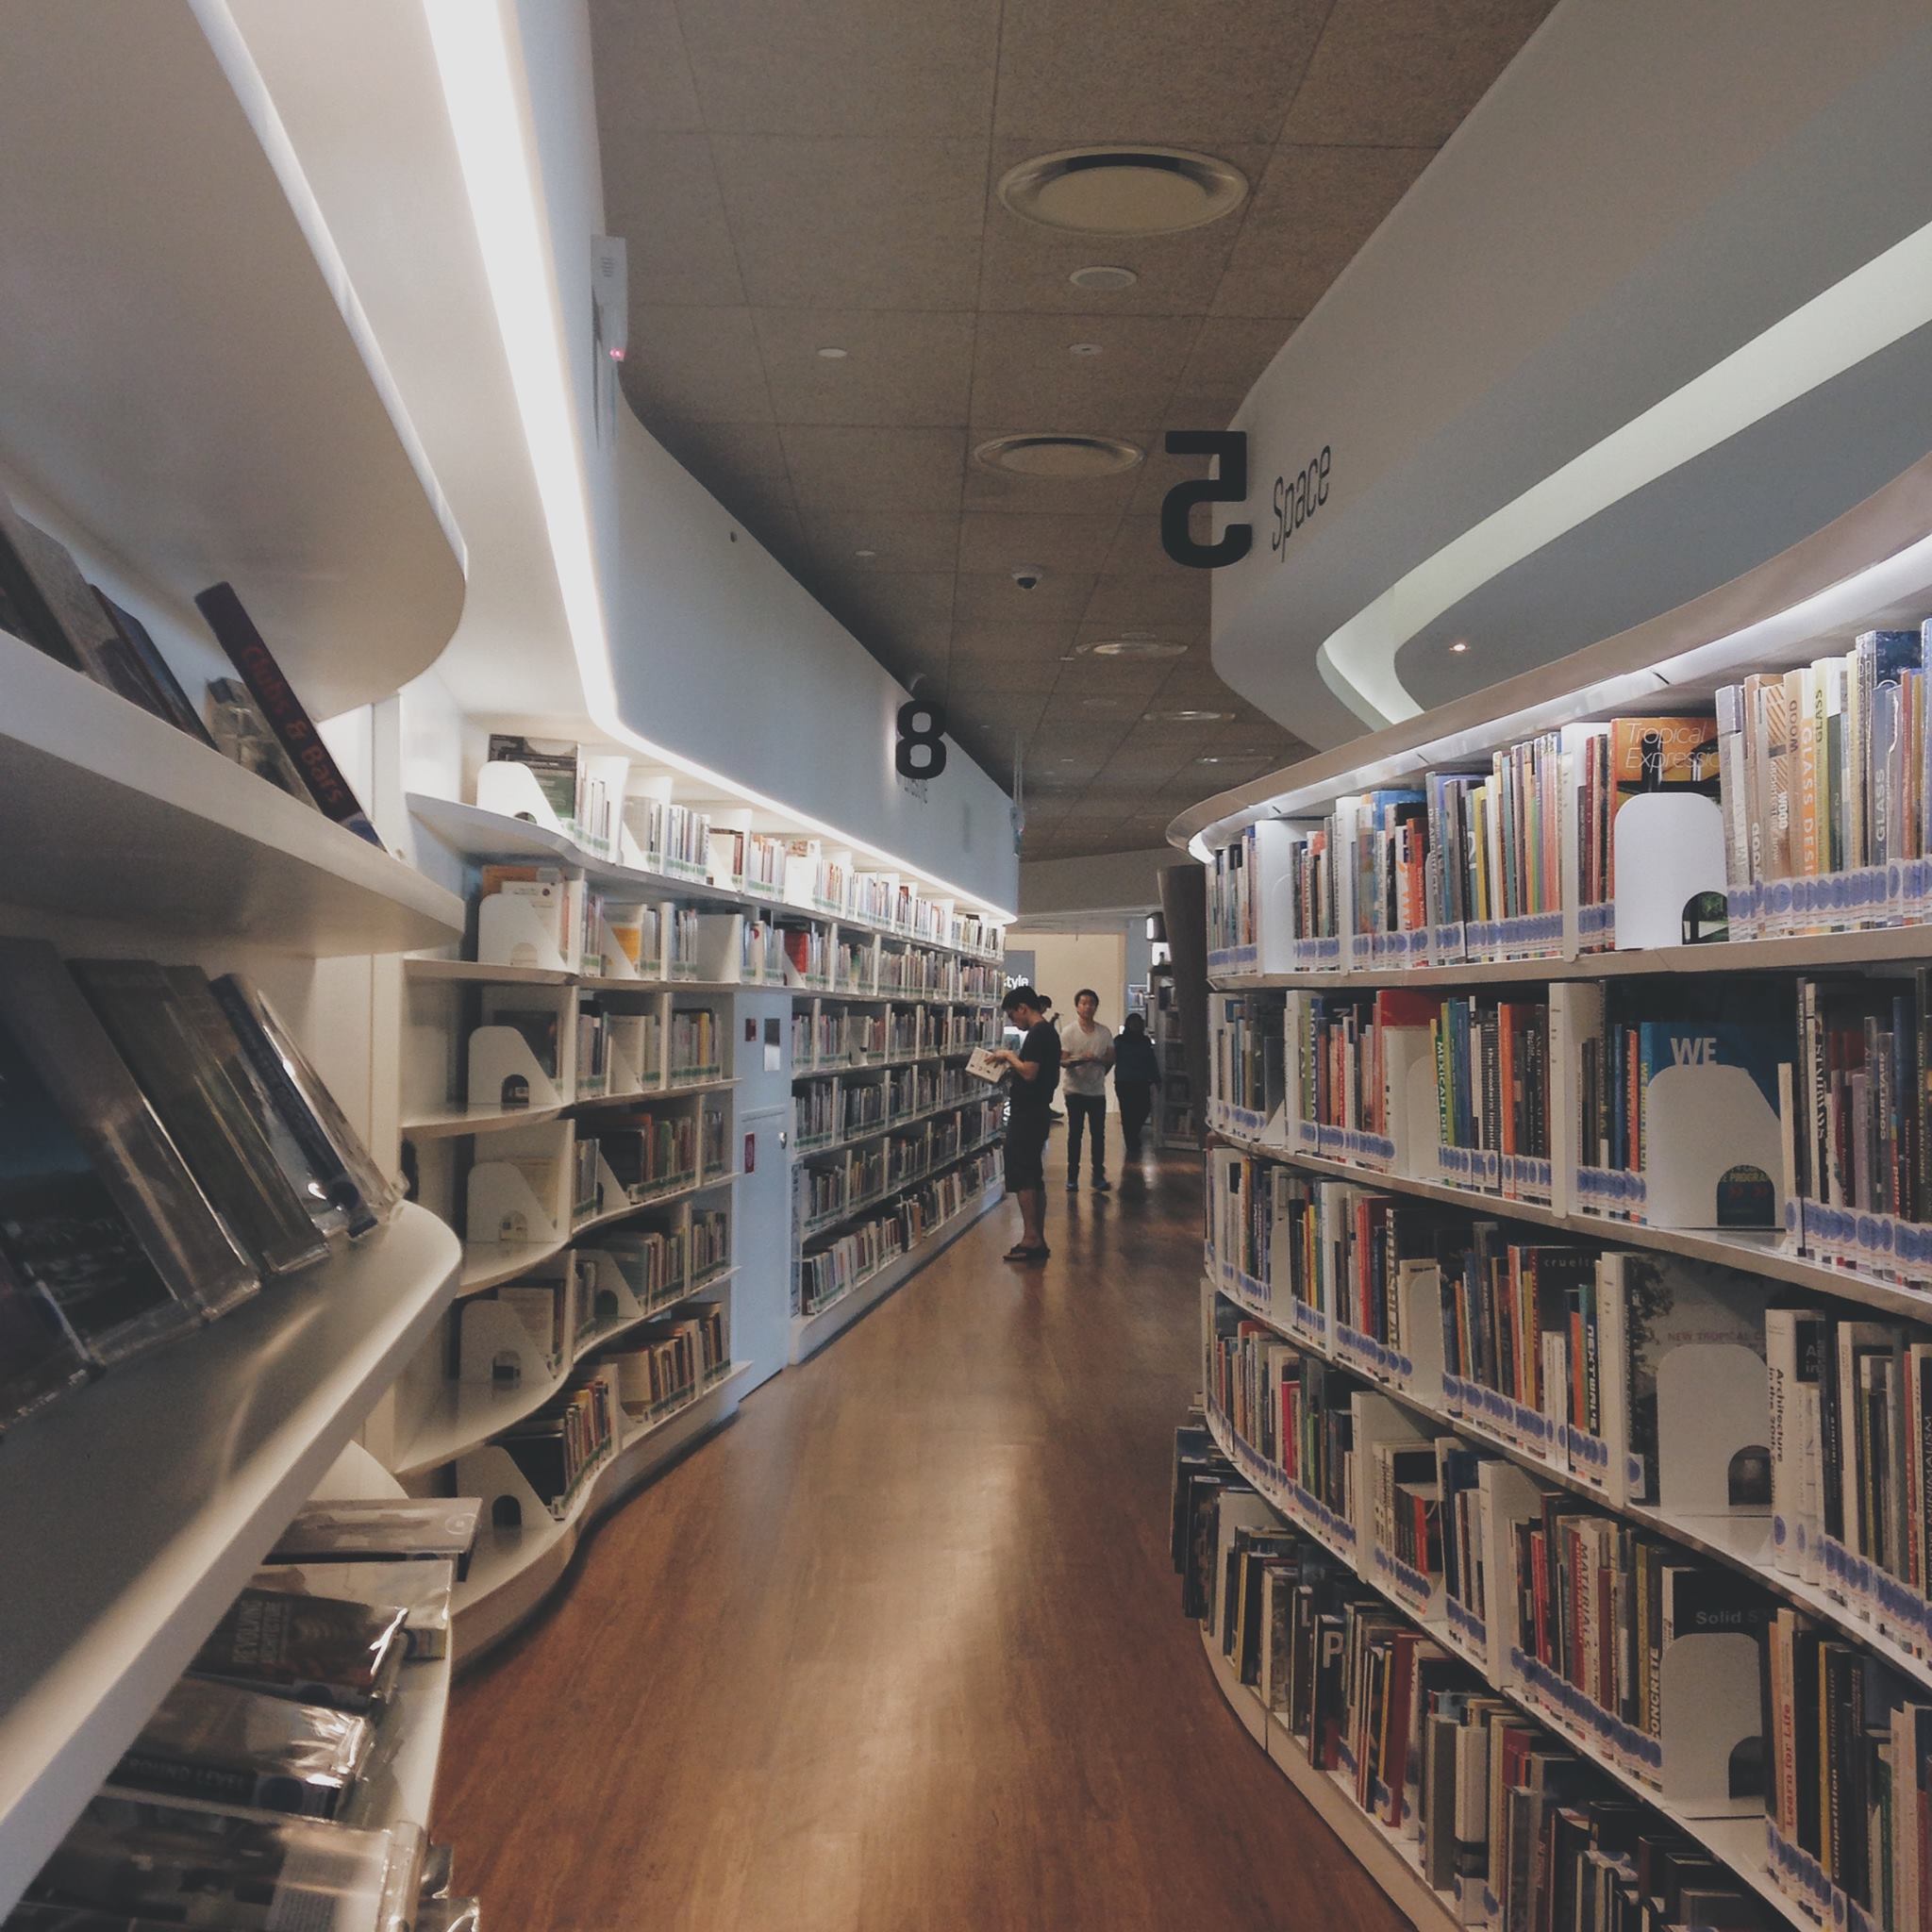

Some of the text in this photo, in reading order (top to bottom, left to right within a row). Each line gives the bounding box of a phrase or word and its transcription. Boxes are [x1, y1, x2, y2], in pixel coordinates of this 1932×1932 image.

[1273, 445, 1331, 562] Space
[895, 700, 947, 780] 8
[1626, 722, 1707, 744] Tropical
[1790, 700, 1799, 753] WOOD
[1625, 747, 1720, 773] Expressio
[1777, 791, 1789, 830] WOOD
[1801, 726, 1814, 875] GLASS DESI
[1874, 769, 1885, 842] GLASS
[1003, 974, 1029, 990] tyle
[1308, 1008, 1317, 1120] OLLECTION
[1437, 1041, 1446, 1108] MEXICAN
[1671, 1038, 1717, 1065] WE
[1878, 1052, 1887, 1141] COURTYARD
[1891, 1165, 1900, 1206] patio
[1543, 1257, 1595, 1268] cruelt
[1776, 1368, 1785, 1462] Architecture
[1580, 1543, 1591, 1650] MATERIALS
[1695, 1609, 1742, 1624] Solid
[1782, 1704, 1791, 1738] Life
[1783, 1742, 1792, 1770] for
[1828, 1667, 1840, 1880] Competition Architecture
[1784, 1774, 1793, 1827] Learn
